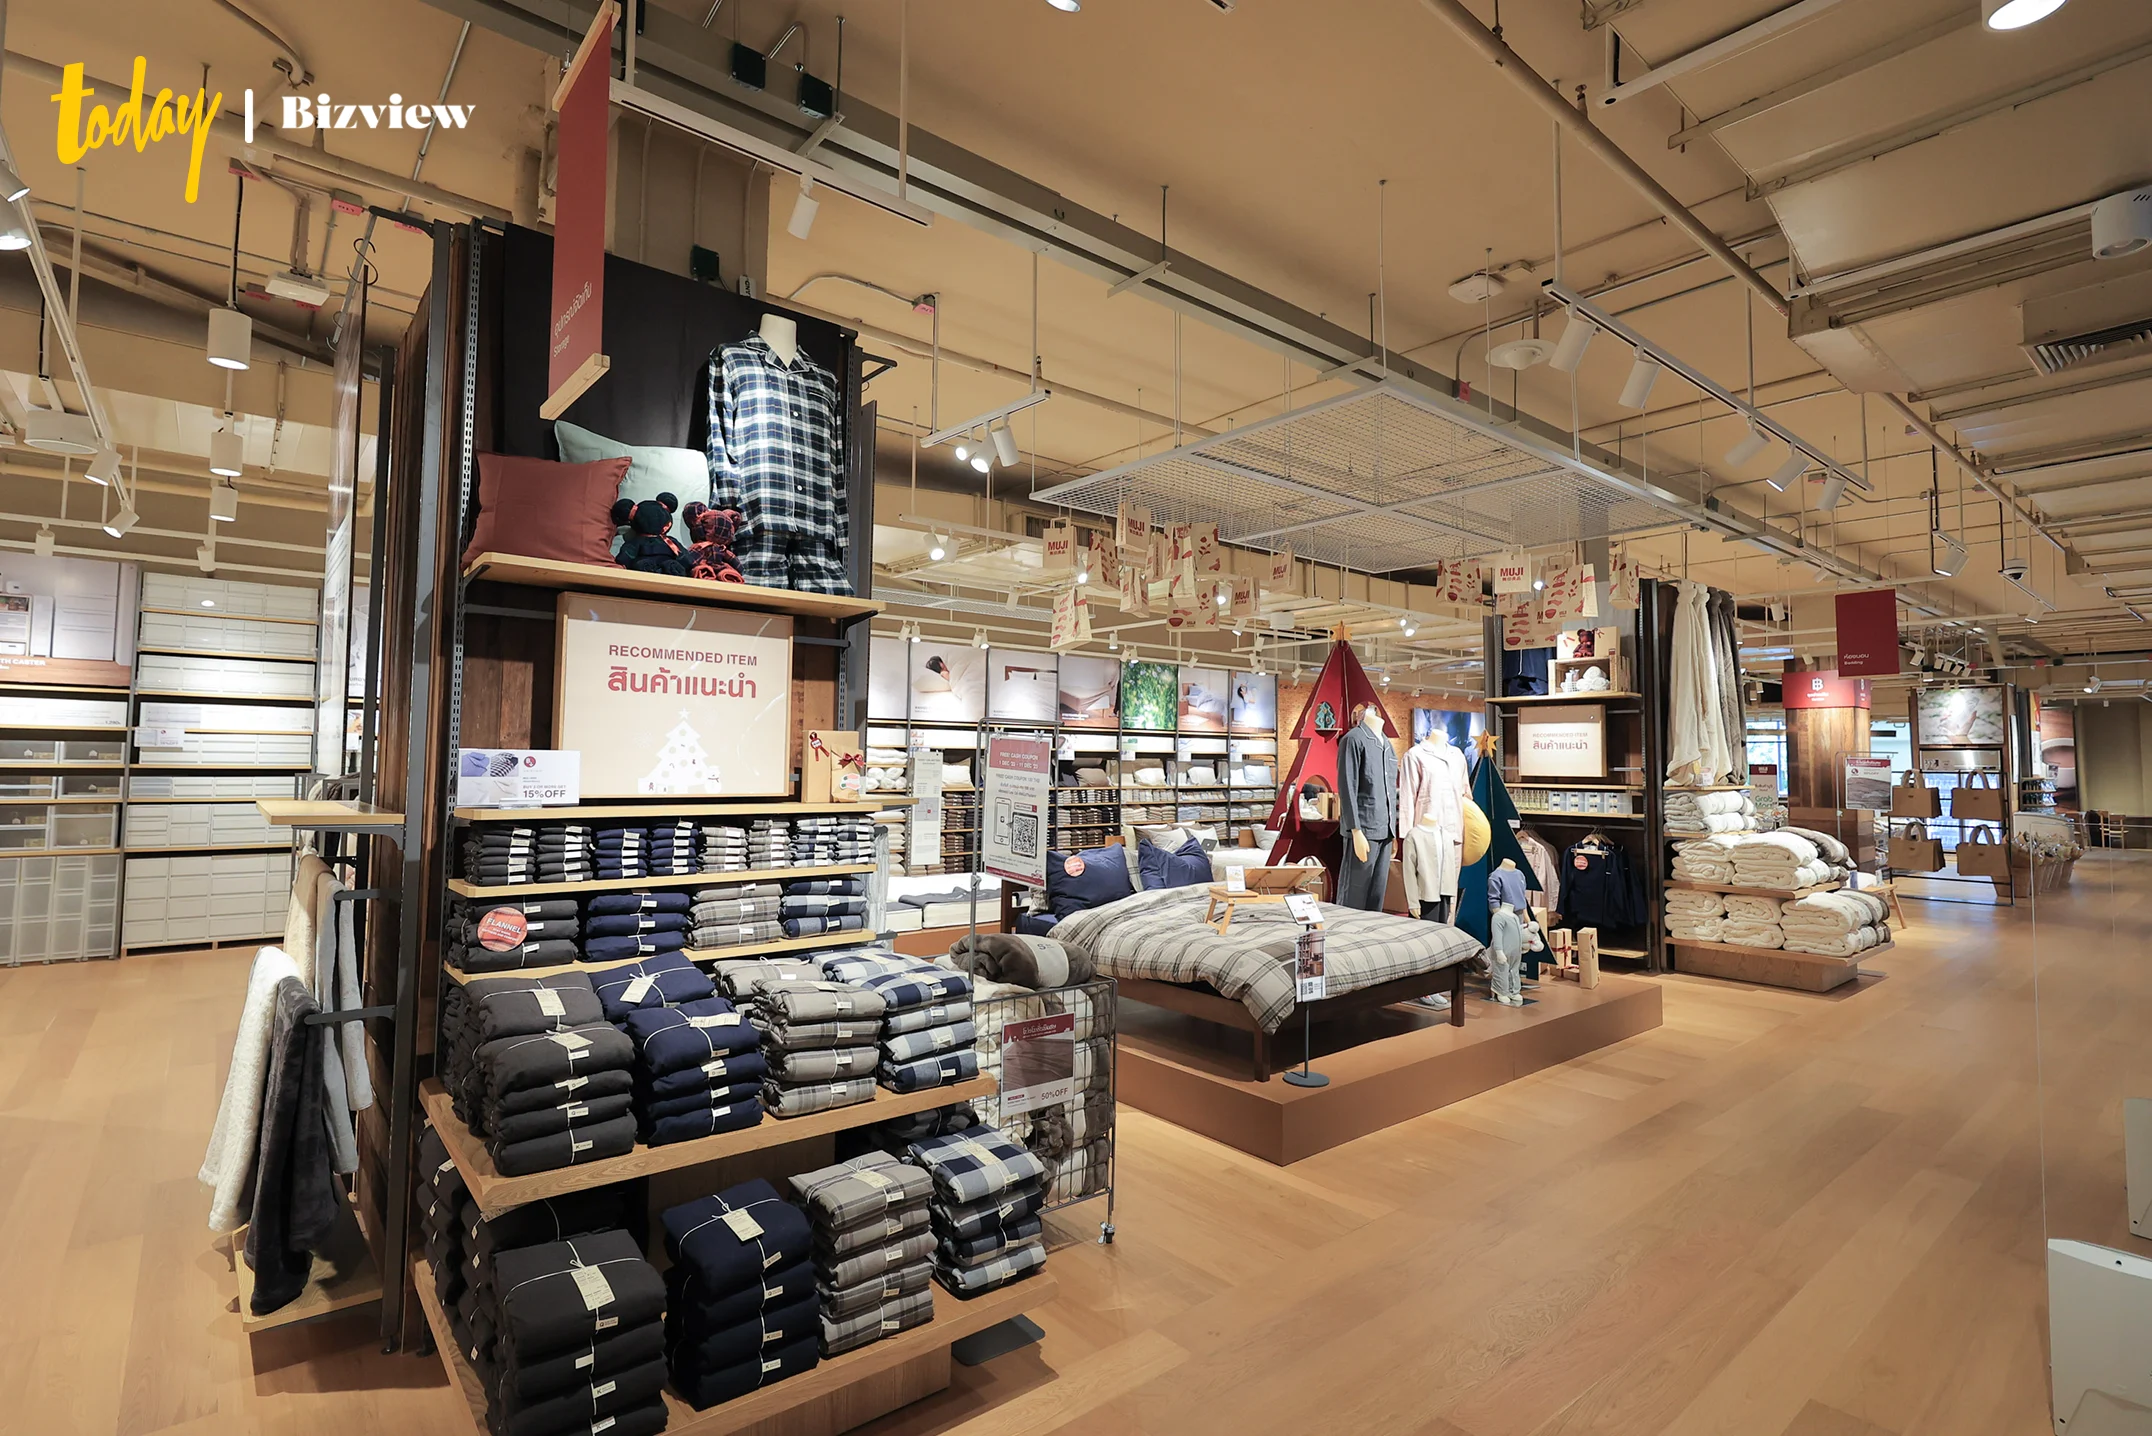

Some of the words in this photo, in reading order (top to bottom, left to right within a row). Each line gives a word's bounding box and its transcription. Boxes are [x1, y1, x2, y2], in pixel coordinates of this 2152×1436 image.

[553, 334, 570, 358] Storage
[1128, 517, 1145, 532] MUJI
[1048, 540, 1068, 551] MUJI
[1273, 564, 1288, 576] MUJI
[1500, 567, 1524, 577] MUJI
[1235, 590, 1250, 601] MUJI
[609, 644, 723, 664] RECOMMENDED
[726, 653, 758, 667] ITEM
[12, 658, 46, 666] CASTER
[607, 666, 757, 699] สินค้าแนะนำ
[1533, 740, 1588, 750] สินค้าแนะนำ
[523, 789, 567, 798] 15%OFF
[1754, 795, 1773, 803] Grab
[486, 917, 522, 934] FLANNEL
[1041, 1087, 1069, 1101] 50%OFF
